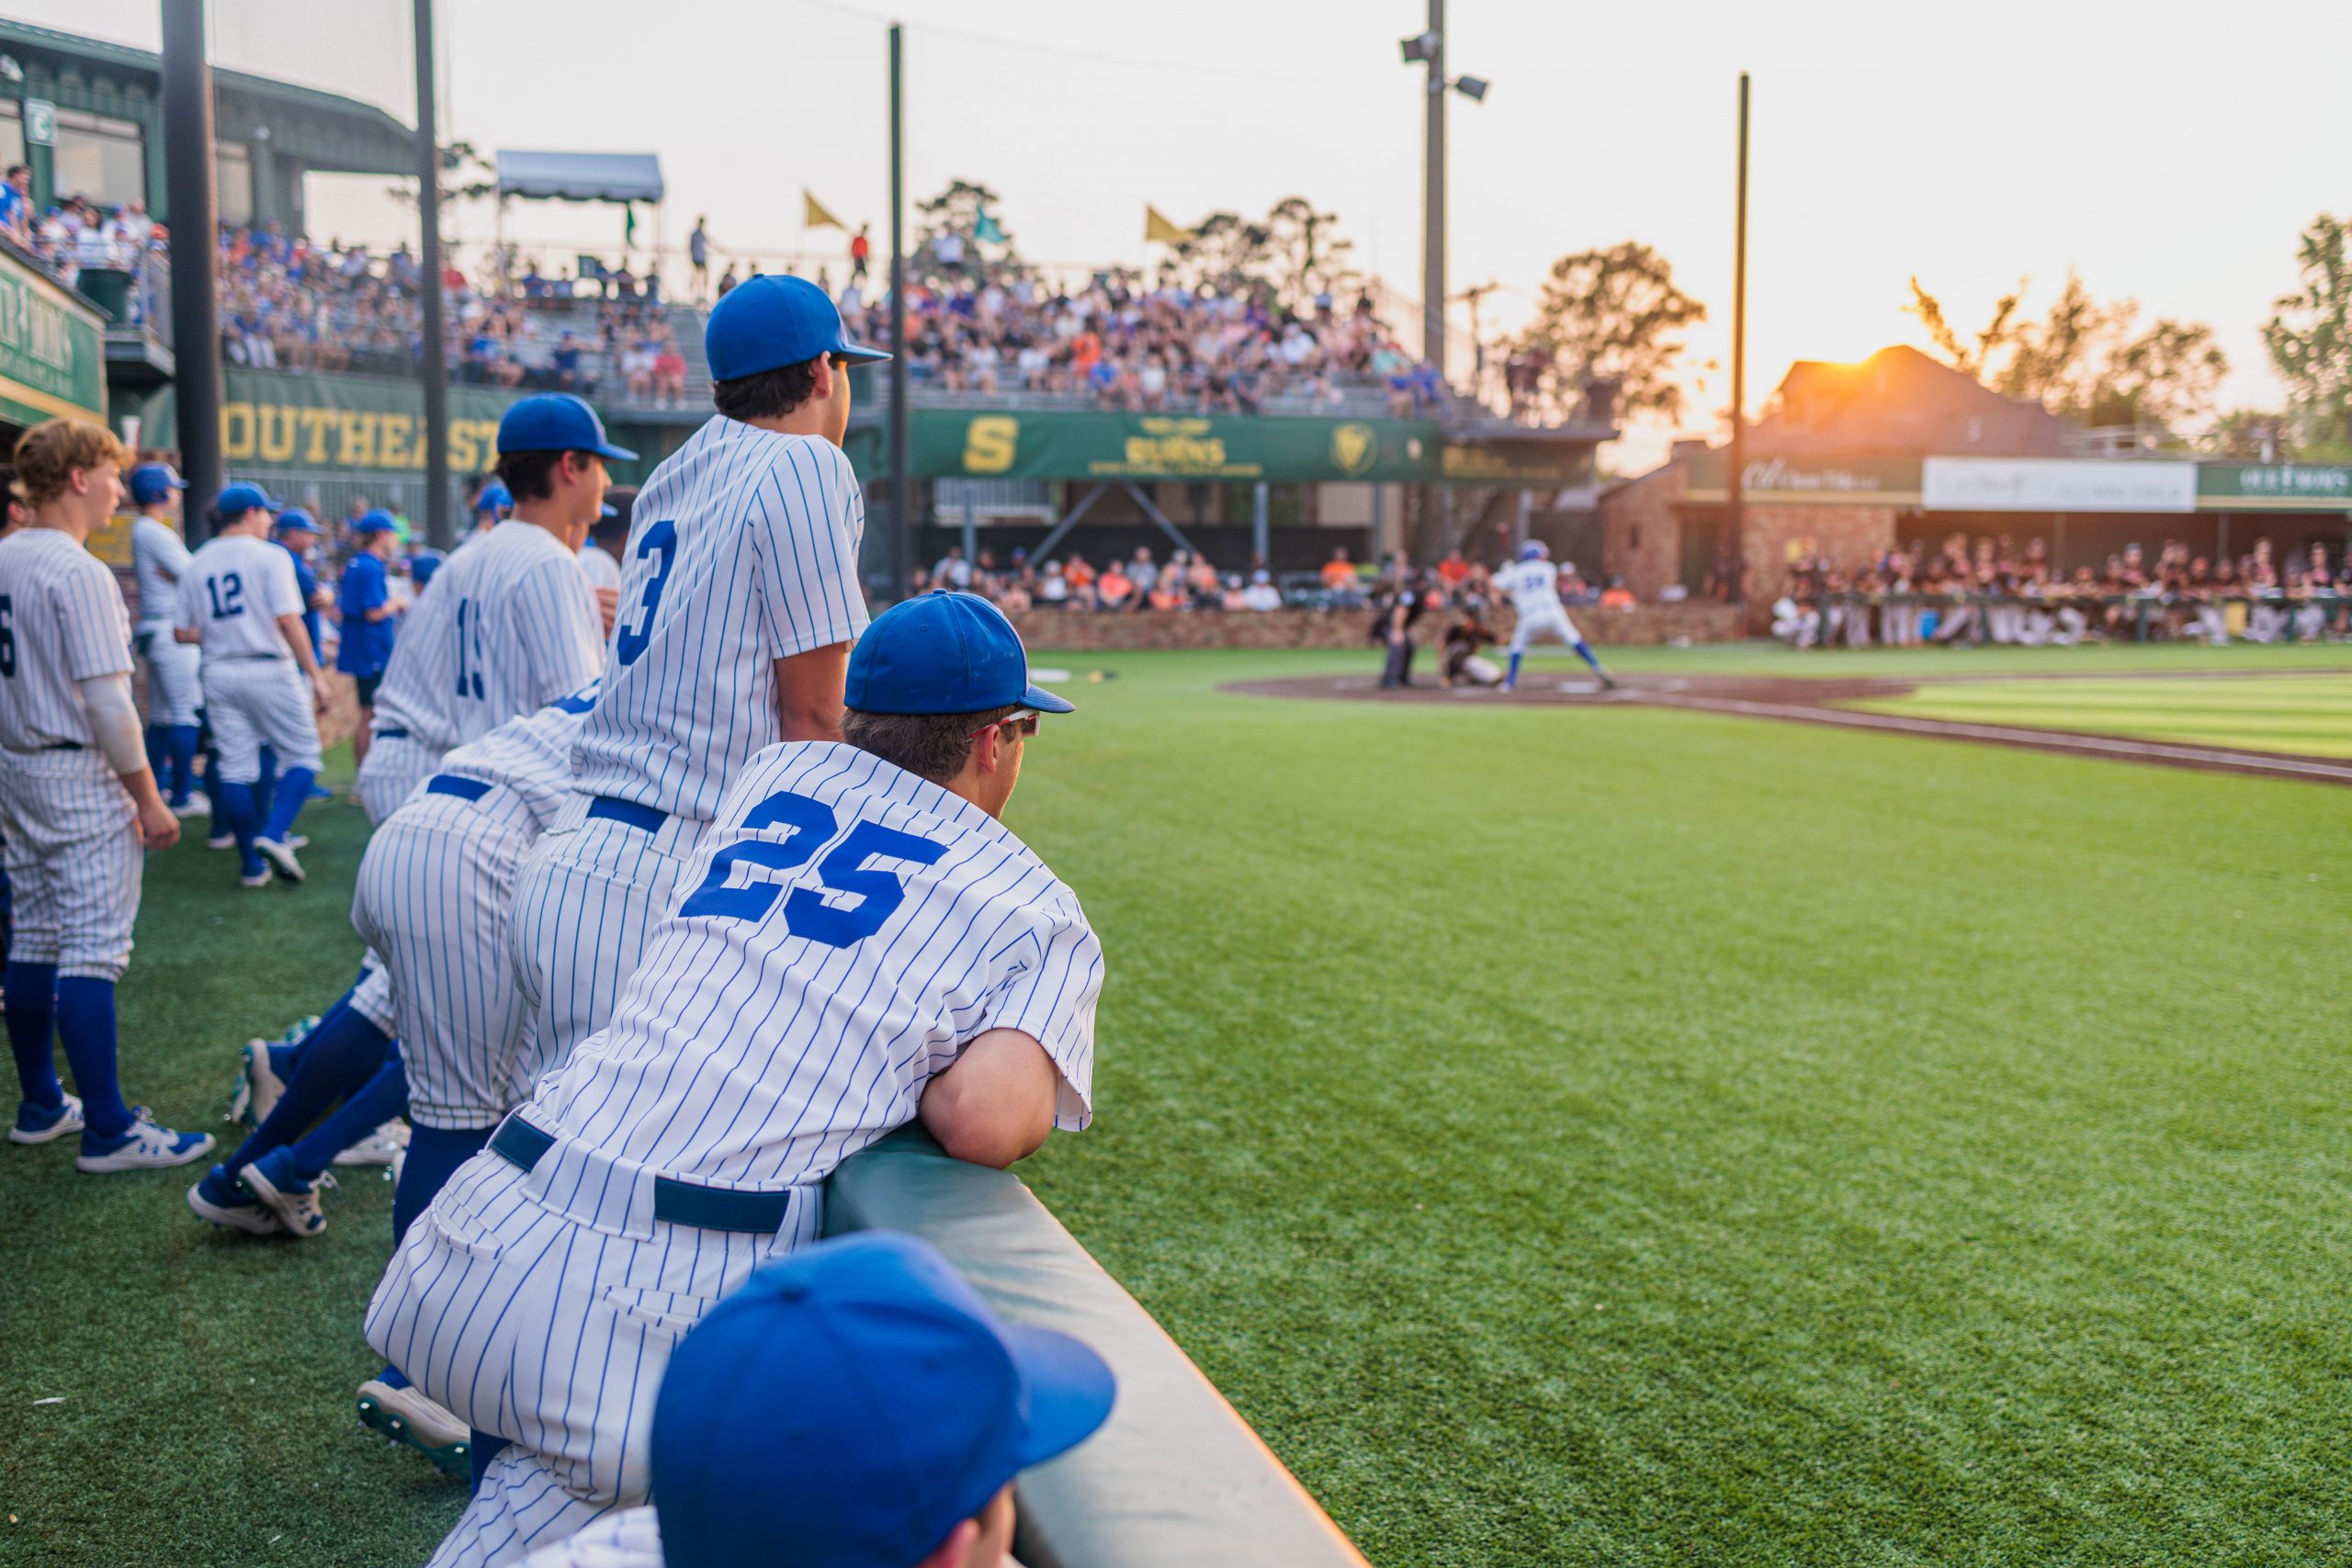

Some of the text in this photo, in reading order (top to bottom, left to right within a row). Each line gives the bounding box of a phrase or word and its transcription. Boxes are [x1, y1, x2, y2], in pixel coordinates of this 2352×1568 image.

[220, 402, 501, 473] OUTHEST
[962, 414, 1018, 473] S
[207, 572, 243, 619] 12
[617, 520, 676, 666] 3
[678, 790, 950, 949] 25
